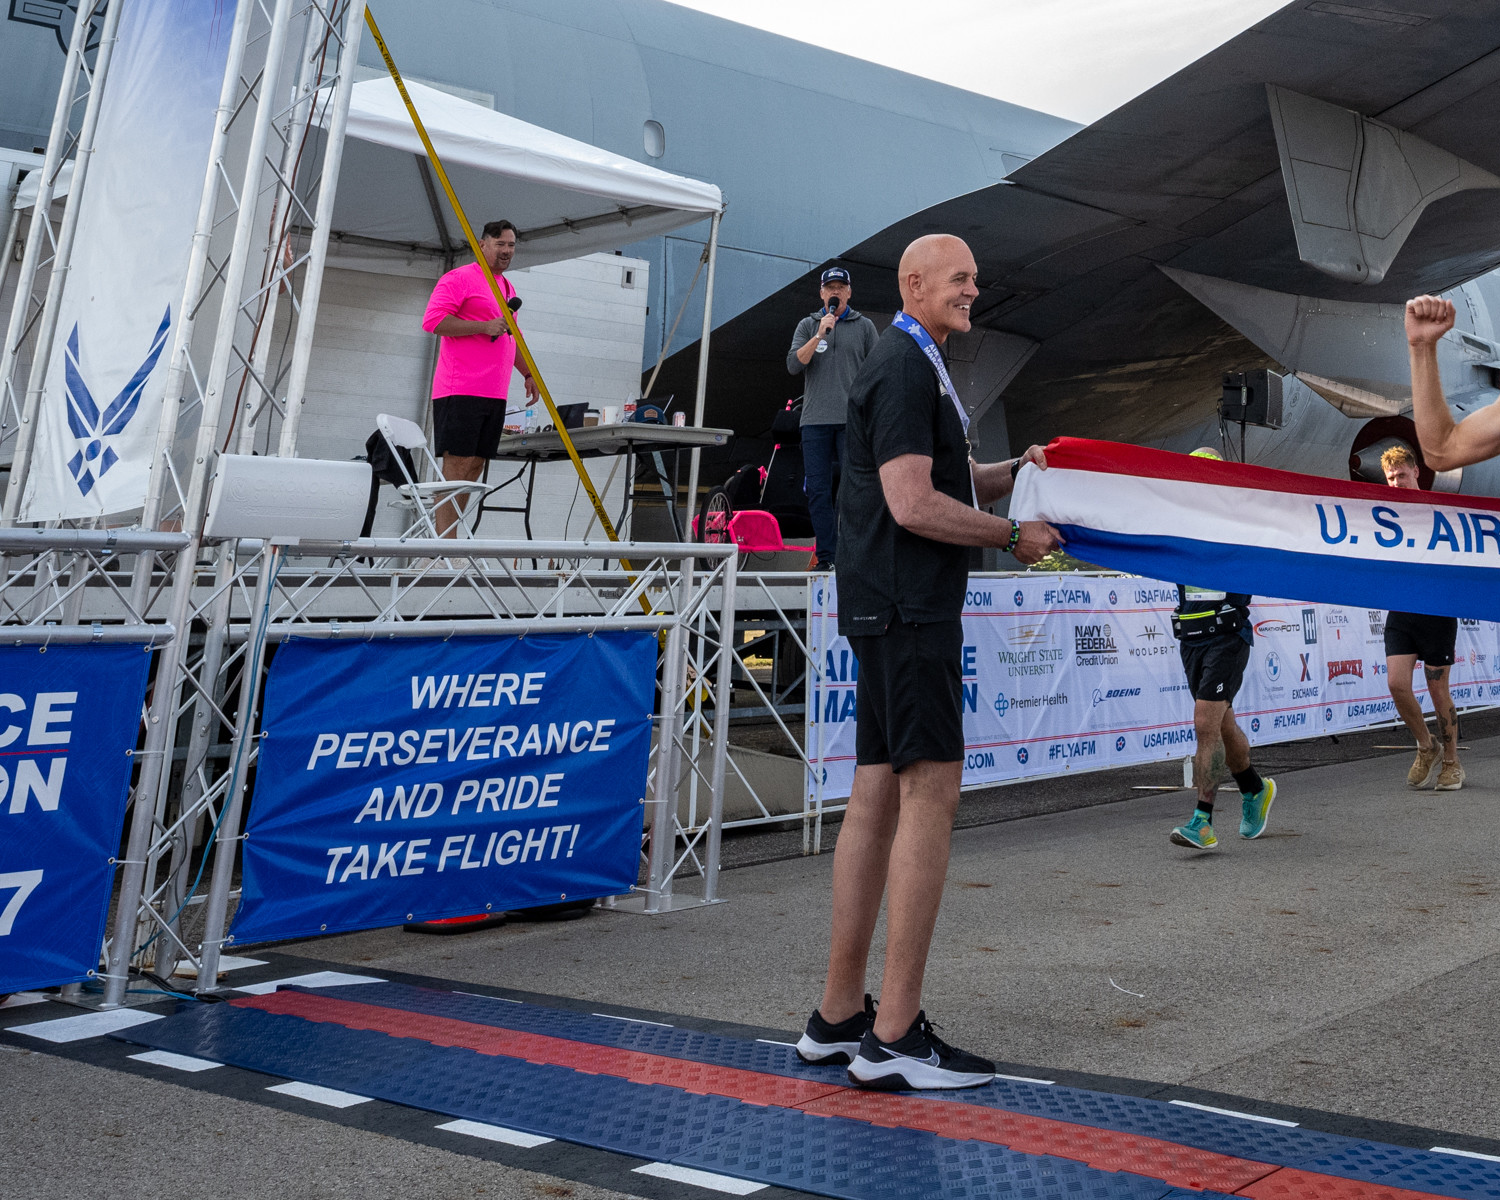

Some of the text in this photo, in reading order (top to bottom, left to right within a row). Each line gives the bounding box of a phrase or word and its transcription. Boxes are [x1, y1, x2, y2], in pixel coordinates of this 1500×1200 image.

[1044, 589, 1091, 604] #FLYAFM
[1326, 616, 1349, 624] ULTRA
[1075, 626, 1101, 637] NAVY
[1075, 637, 1117, 650] FEDERAL
[1129, 646, 1175, 656] WOOLPERT
[998, 649, 1063, 664] WRIGHT STATE
[1076, 655, 1118, 666] Credit Union
[1008, 664, 1054, 677] UNIVERSITY
[410, 671, 546, 709] WHERE
[1106, 688, 1141, 698] BOEING
[1293, 687, 1319, 700] EXCHANGE
[1010, 693, 1068, 709] Premier Health
[1274, 713, 1306, 728] #FLYAFM
[306, 719, 615, 771] PERSEVERANCE
[1049, 741, 1096, 759] #FLYAFM
[353, 772, 565, 824] AND PRIDE
[325, 824, 581, 885] TAKE FLIGHT!
